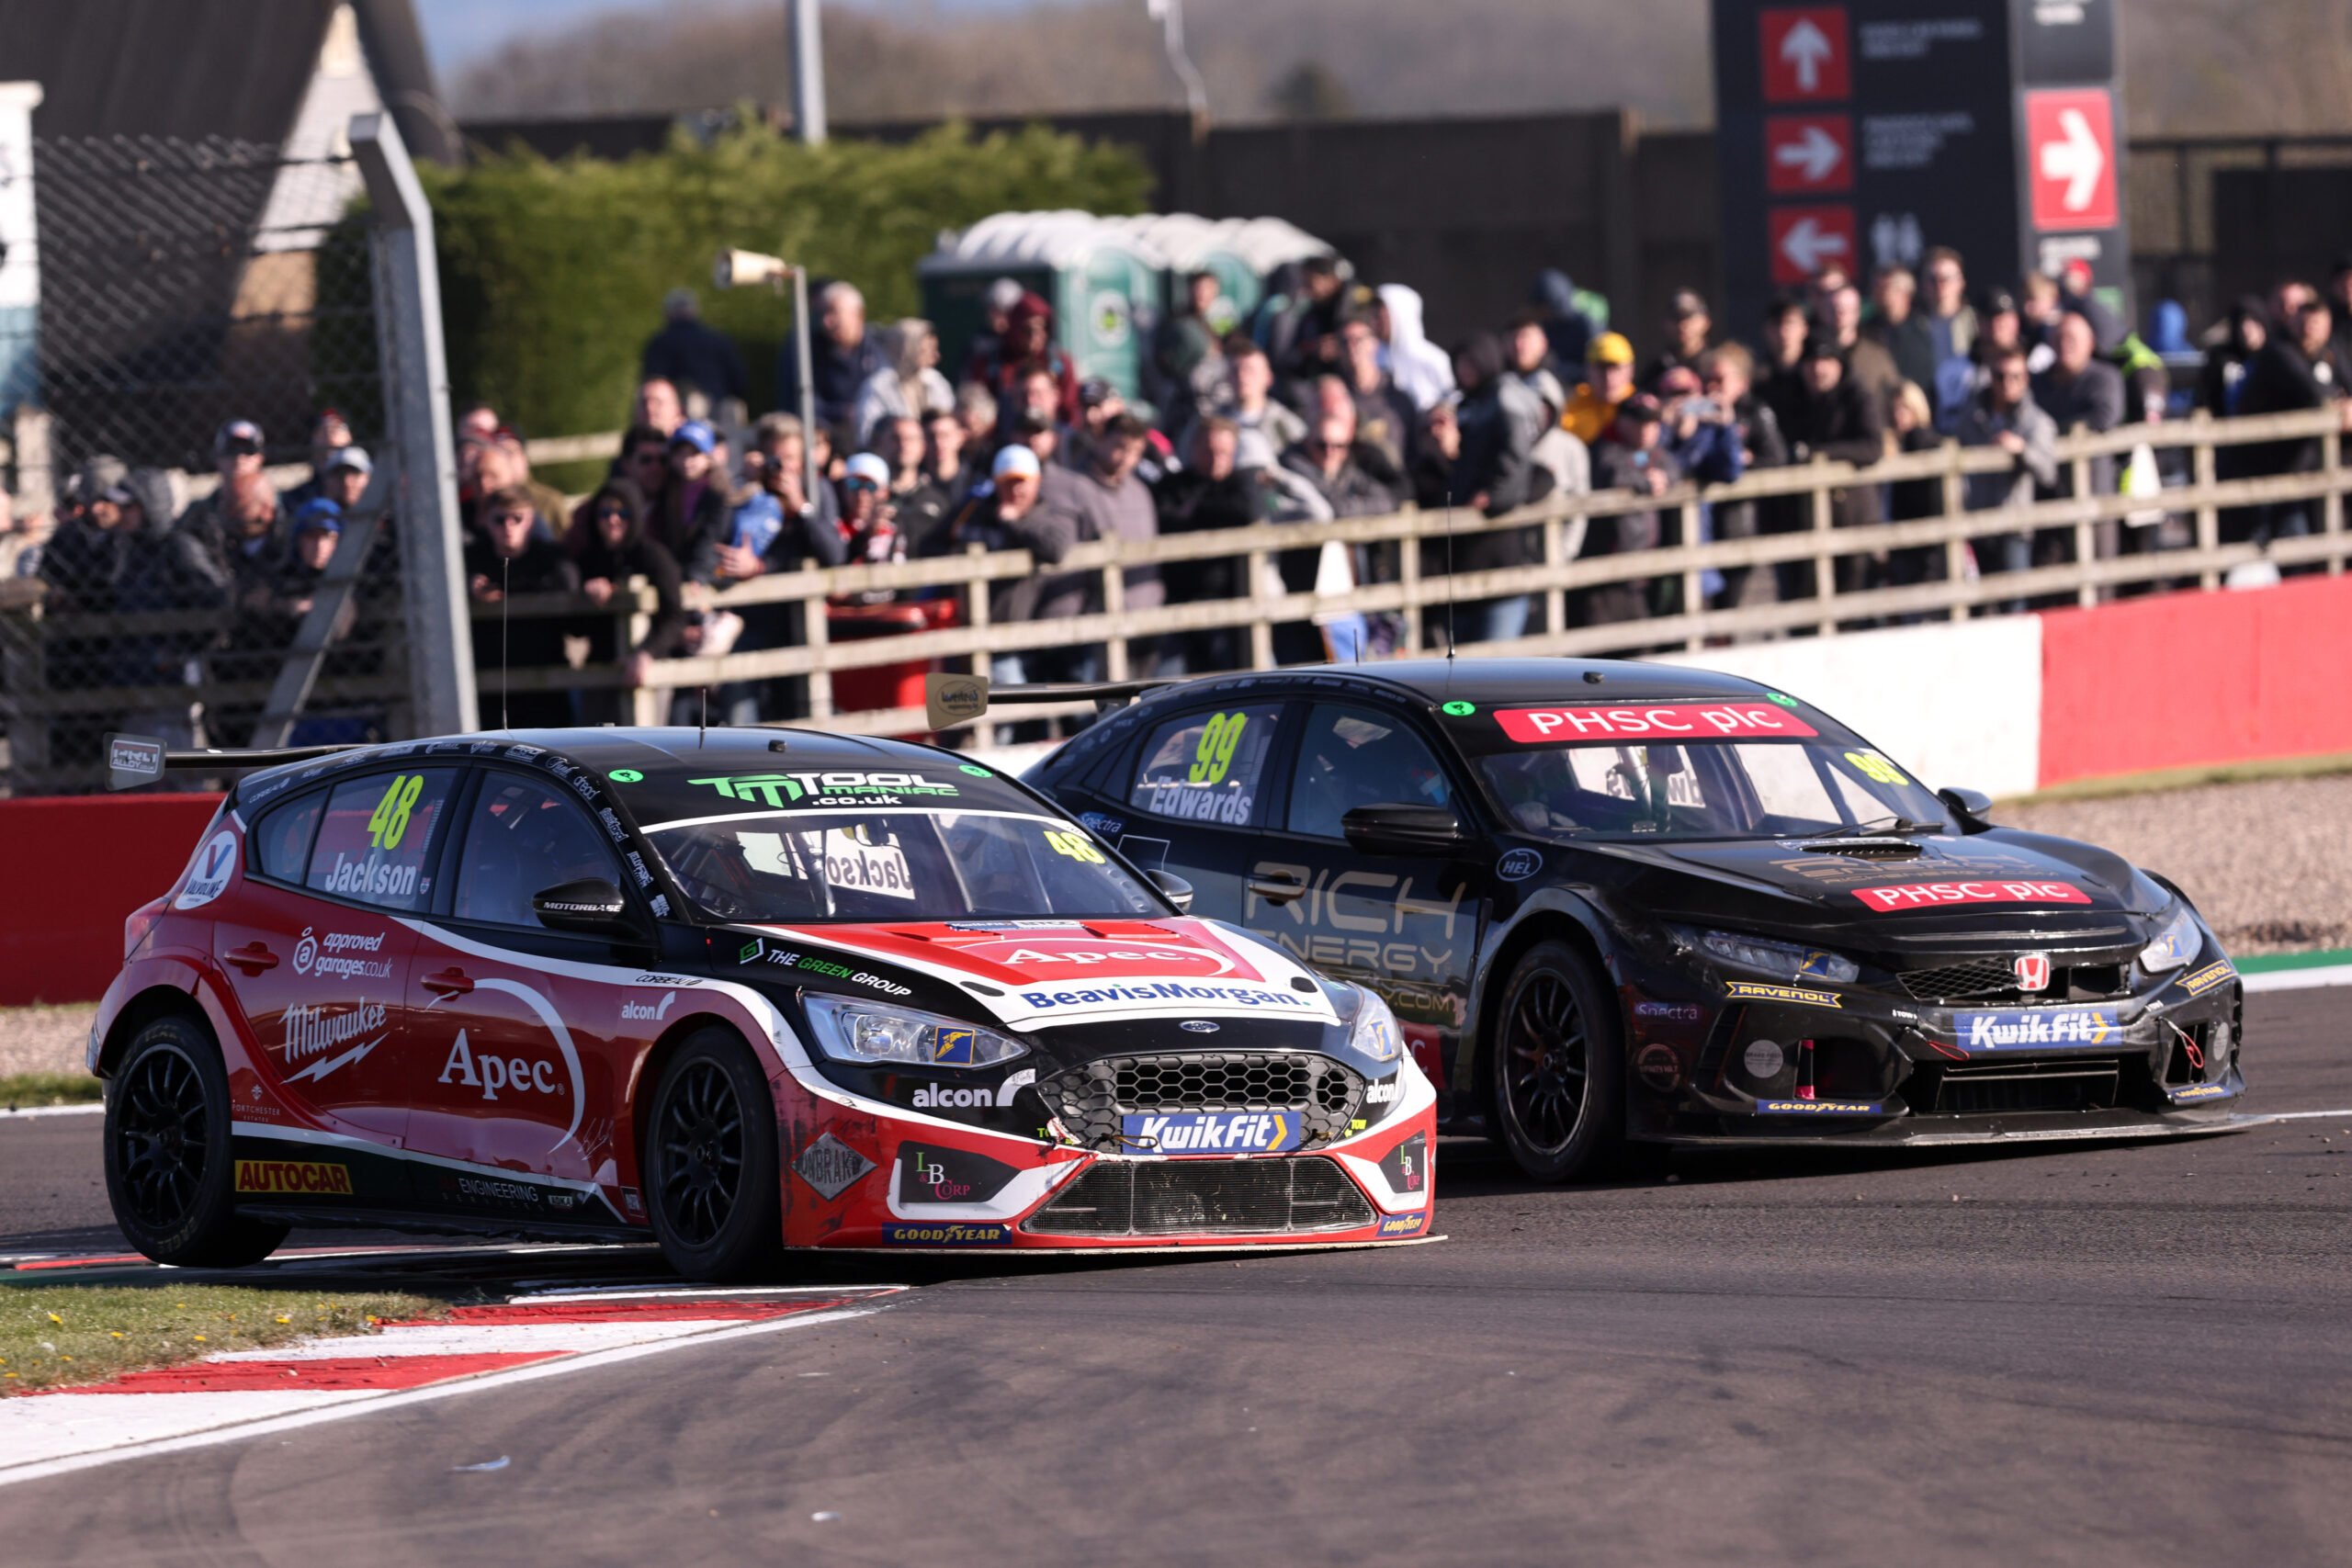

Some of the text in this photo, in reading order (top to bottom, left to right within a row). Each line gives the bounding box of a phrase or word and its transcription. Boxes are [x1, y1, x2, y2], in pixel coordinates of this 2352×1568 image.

[1528, 706, 1783, 735] PHSC plc
[1189, 712, 1247, 784] 99
[1844, 752, 1909, 785] 99
[812, 795, 901, 806] .co.uk
[821, 786, 960, 796] MANIAC
[1149, 775, 1252, 825] Edwards
[368, 775, 424, 850] 48
[1044, 831, 1106, 864] 48
[325, 852, 417, 895] Jackson
[1502, 861, 1532, 874] HEL
[1247, 862, 1466, 940] RICH
[1872, 882, 2069, 906] PHSC plc
[543, 901, 623, 913] MOTORBASE
[323, 932, 386, 953] approved
[1254, 931, 1452, 975] NERGY
[314, 956, 394, 979] garages.co.uk
[766, 949, 911, 997] THE GREEN GROUP
[2187, 965, 2232, 989] RAVENOL
[1739, 986, 1830, 1002] RAVENOL
[622, 1000, 655, 1020] alcon
[278, 997, 387, 1064] Milwaukee
[912, 1083, 992, 1108] alcon
[1351, 1120, 1367, 1130] TOW
[239, 1162, 350, 1192] AUTOCAR
[458, 1178, 539, 1202] ENGINEERING
[894, 1226, 1001, 1242] GOODYEAR
